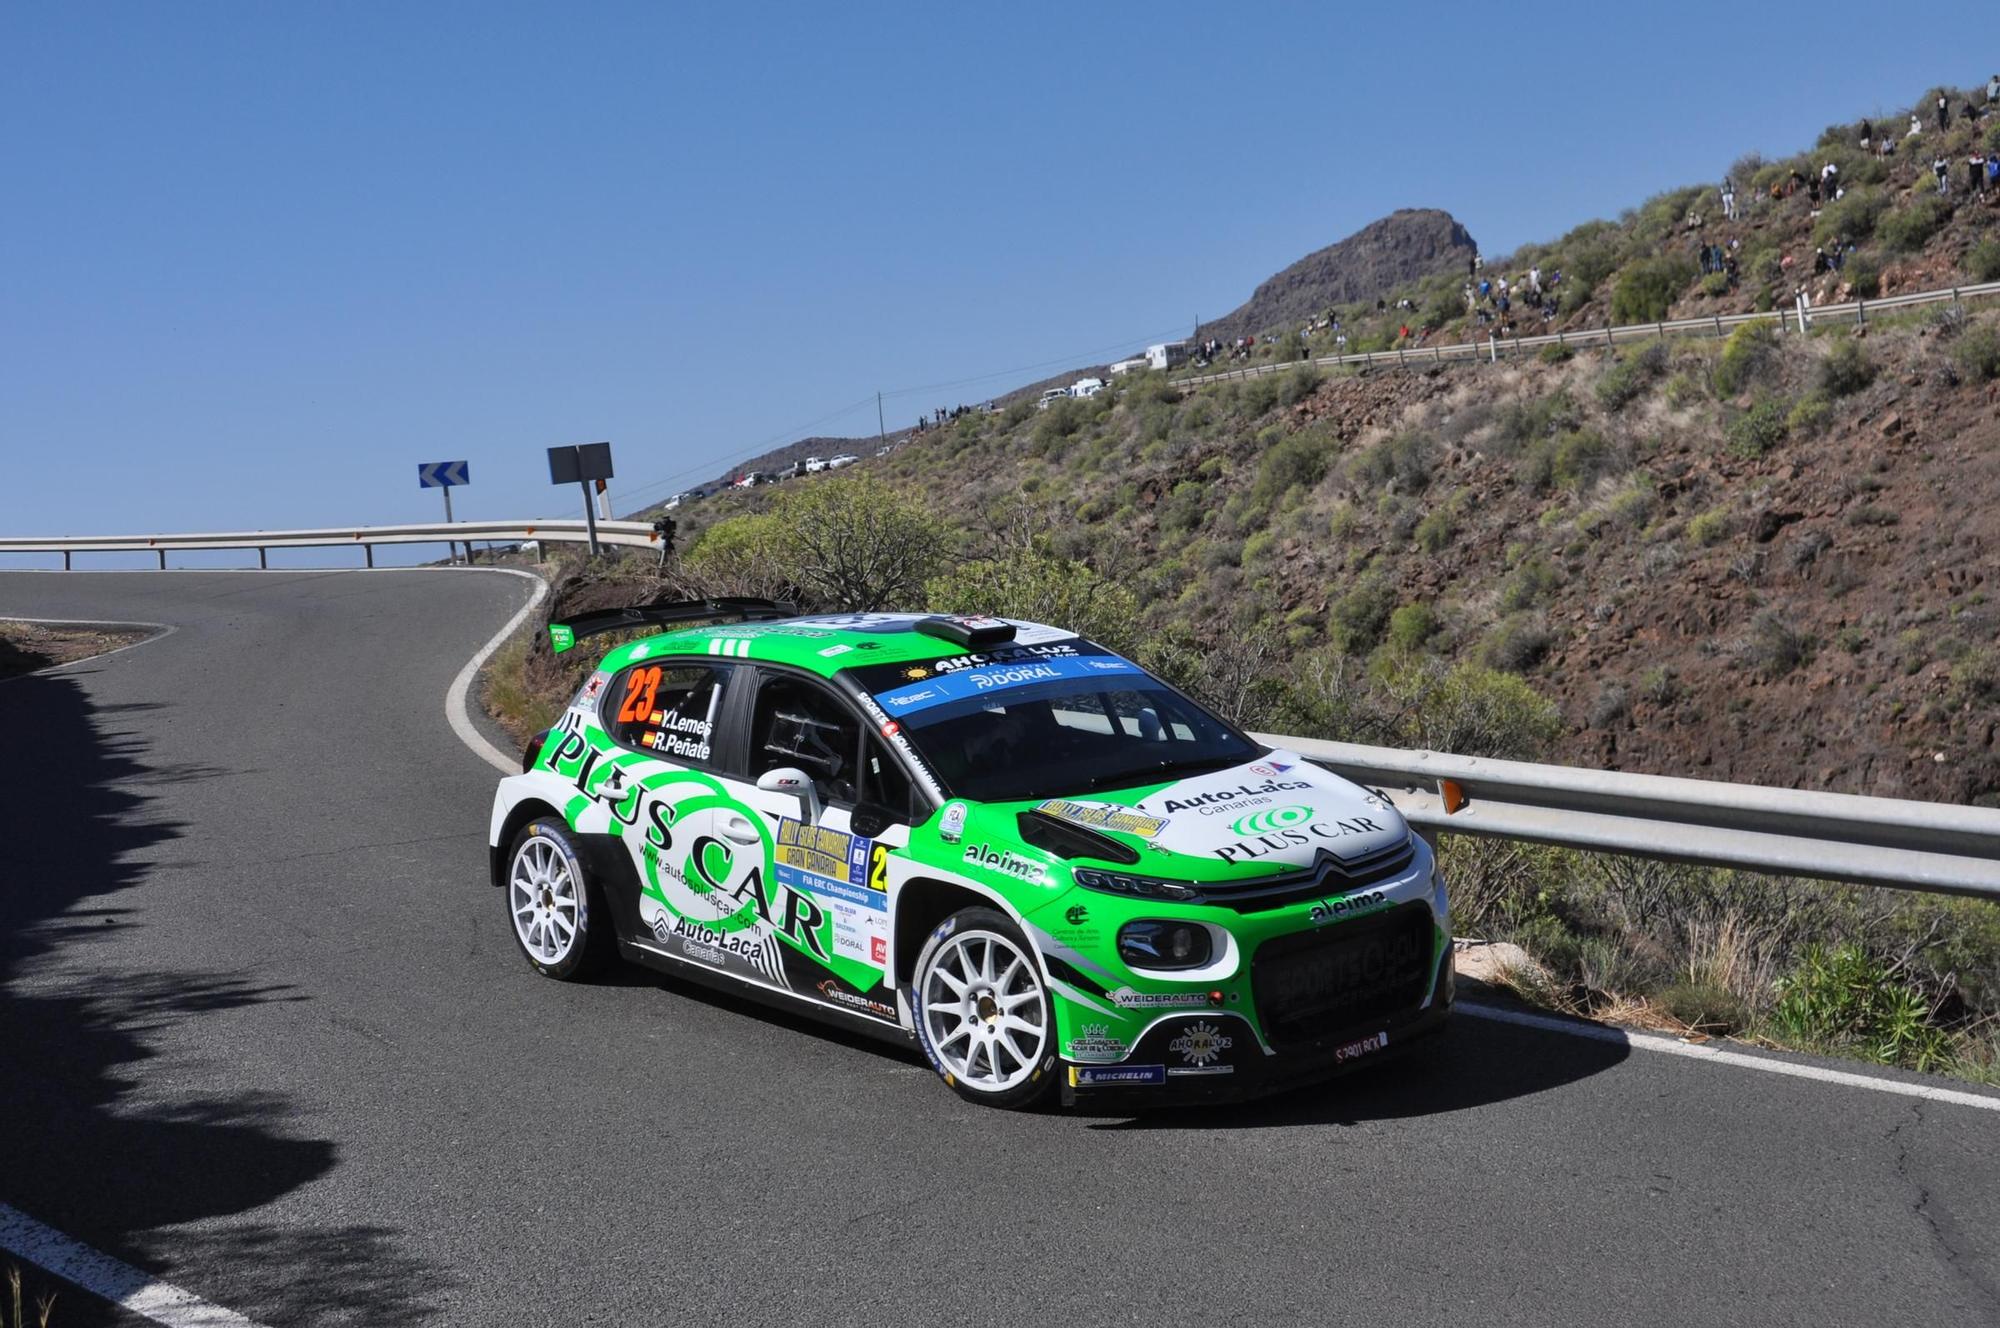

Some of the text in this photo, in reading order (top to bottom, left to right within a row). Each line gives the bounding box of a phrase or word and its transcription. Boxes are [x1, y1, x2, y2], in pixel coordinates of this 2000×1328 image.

[992, 667, 1062, 685] DORAL
[617, 667, 663, 722] 23
[661, 709, 713, 737] Y.Lemes
[652, 731, 711, 760] R.Peñate
[1199, 797, 1272, 816] Canarias
[546, 728, 829, 962] PLUS CAR
[1211, 817, 1387, 866] PLUS CAR
[871, 846, 888, 891] 2
[965, 844, 1044, 880] aleima
[638, 842, 762, 937] www.autospluscar.com
[1311, 890, 1386, 919] aleima
[673, 916, 763, 959] Auto-Laca
[682, 940, 726, 965] Canarias
[828, 988, 896, 1016] WEIDERAUTO
[1121, 993, 1206, 1003] WEIDERAUTO
[1095, 1072, 1154, 1081] MICHELIN
